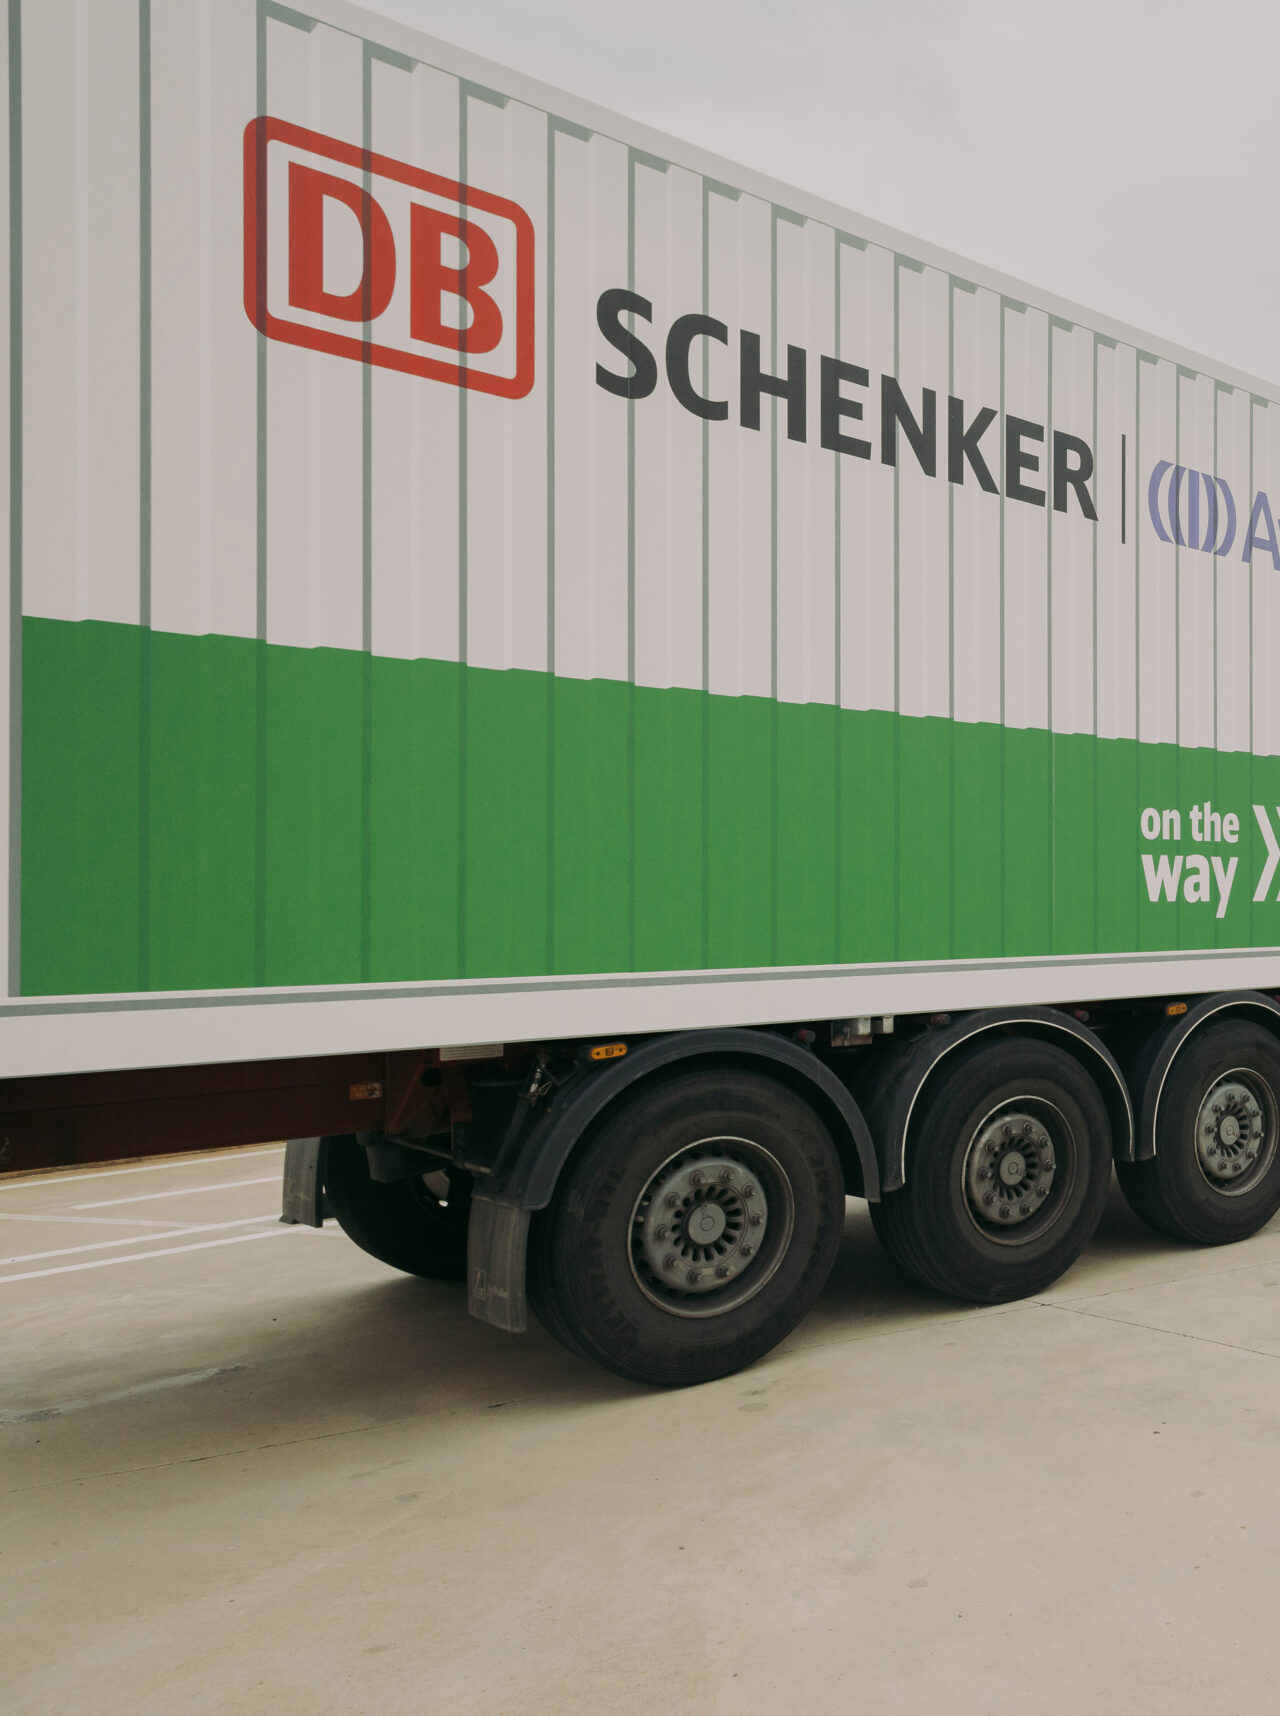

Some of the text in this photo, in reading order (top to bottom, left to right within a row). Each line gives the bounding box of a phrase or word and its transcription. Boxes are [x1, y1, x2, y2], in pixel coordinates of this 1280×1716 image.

[287, 161, 1099, 522] DB SCHENKER
[1140, 800, 1240, 844] on the
[1140, 853, 1239, 919] way
